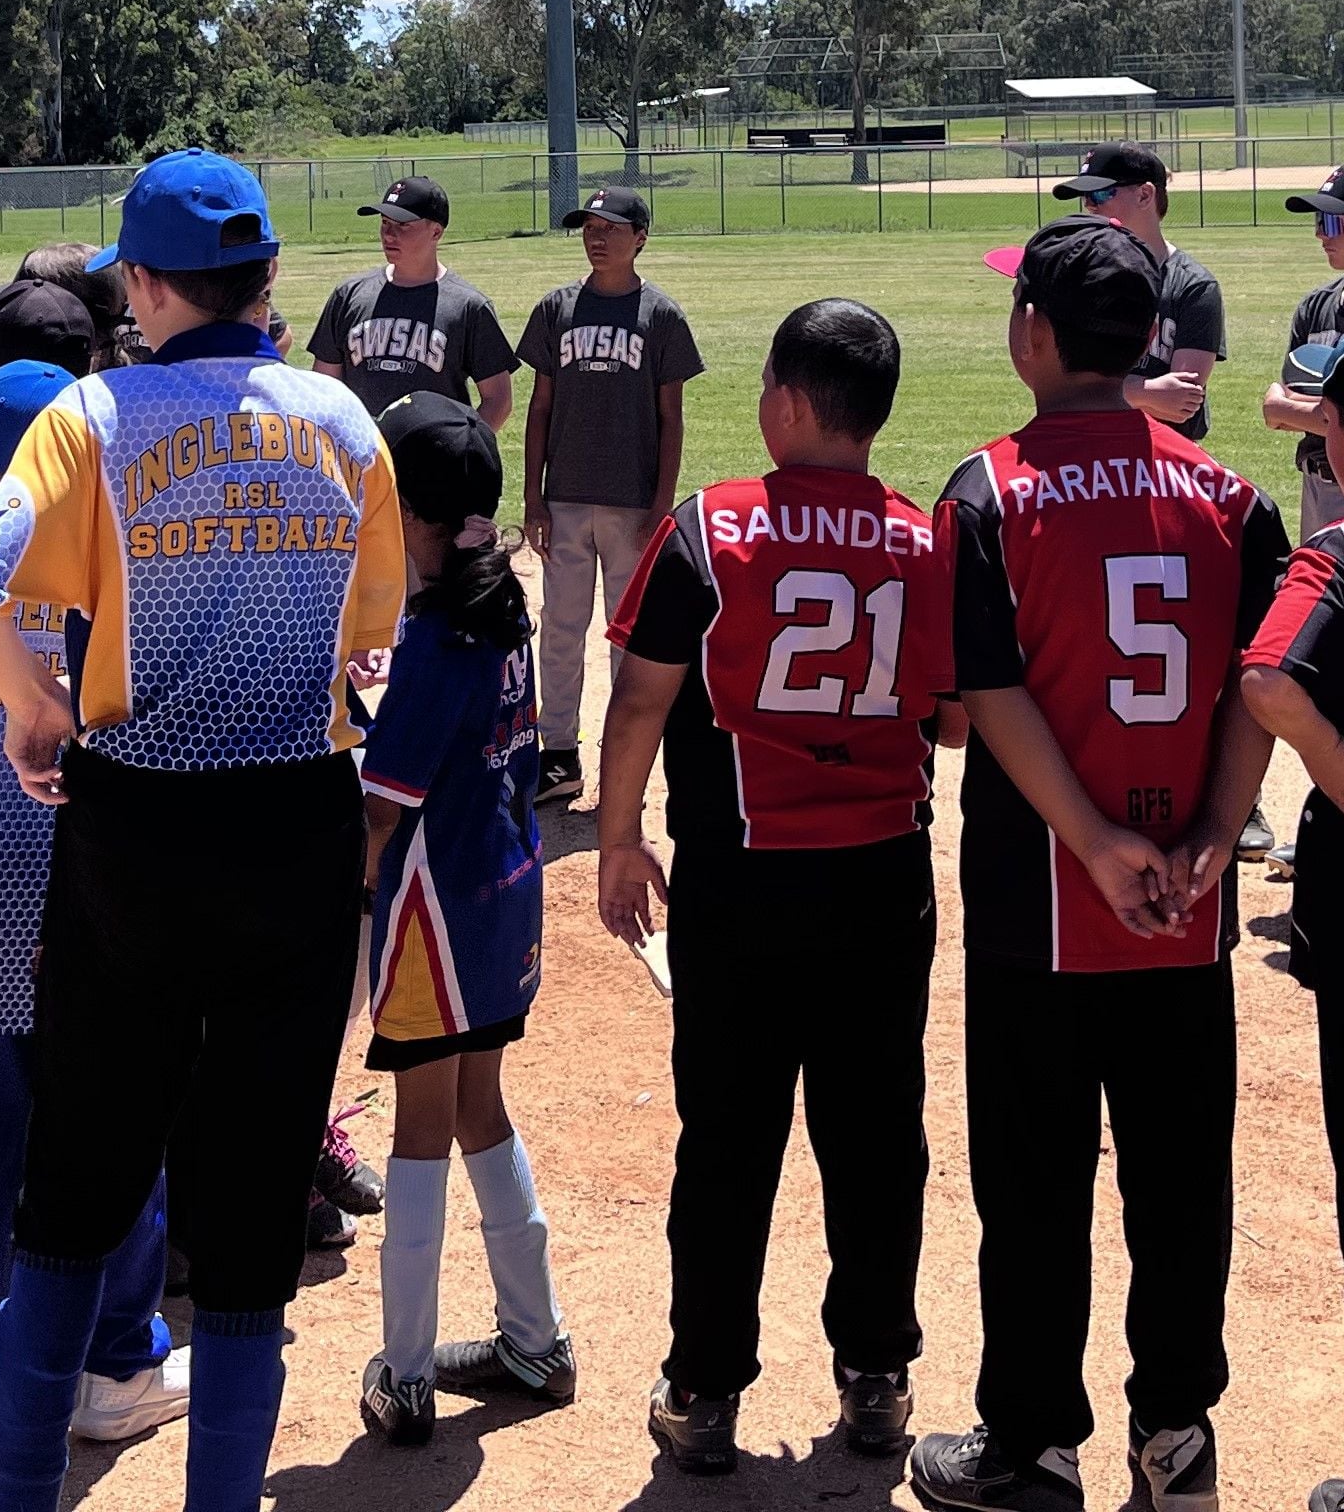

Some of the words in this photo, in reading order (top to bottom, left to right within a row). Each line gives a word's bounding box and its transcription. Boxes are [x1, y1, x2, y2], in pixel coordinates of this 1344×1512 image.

[348, 317, 448, 373] SWSAS
[559, 325, 645, 370] SWSAS
[124, 412, 363, 522] INGLEBURN
[224, 481, 285, 510] RSL
[129, 515, 356, 559] SOFTBALL
[756, 568, 905, 717] 21
[1103, 553, 1189, 726] 5
